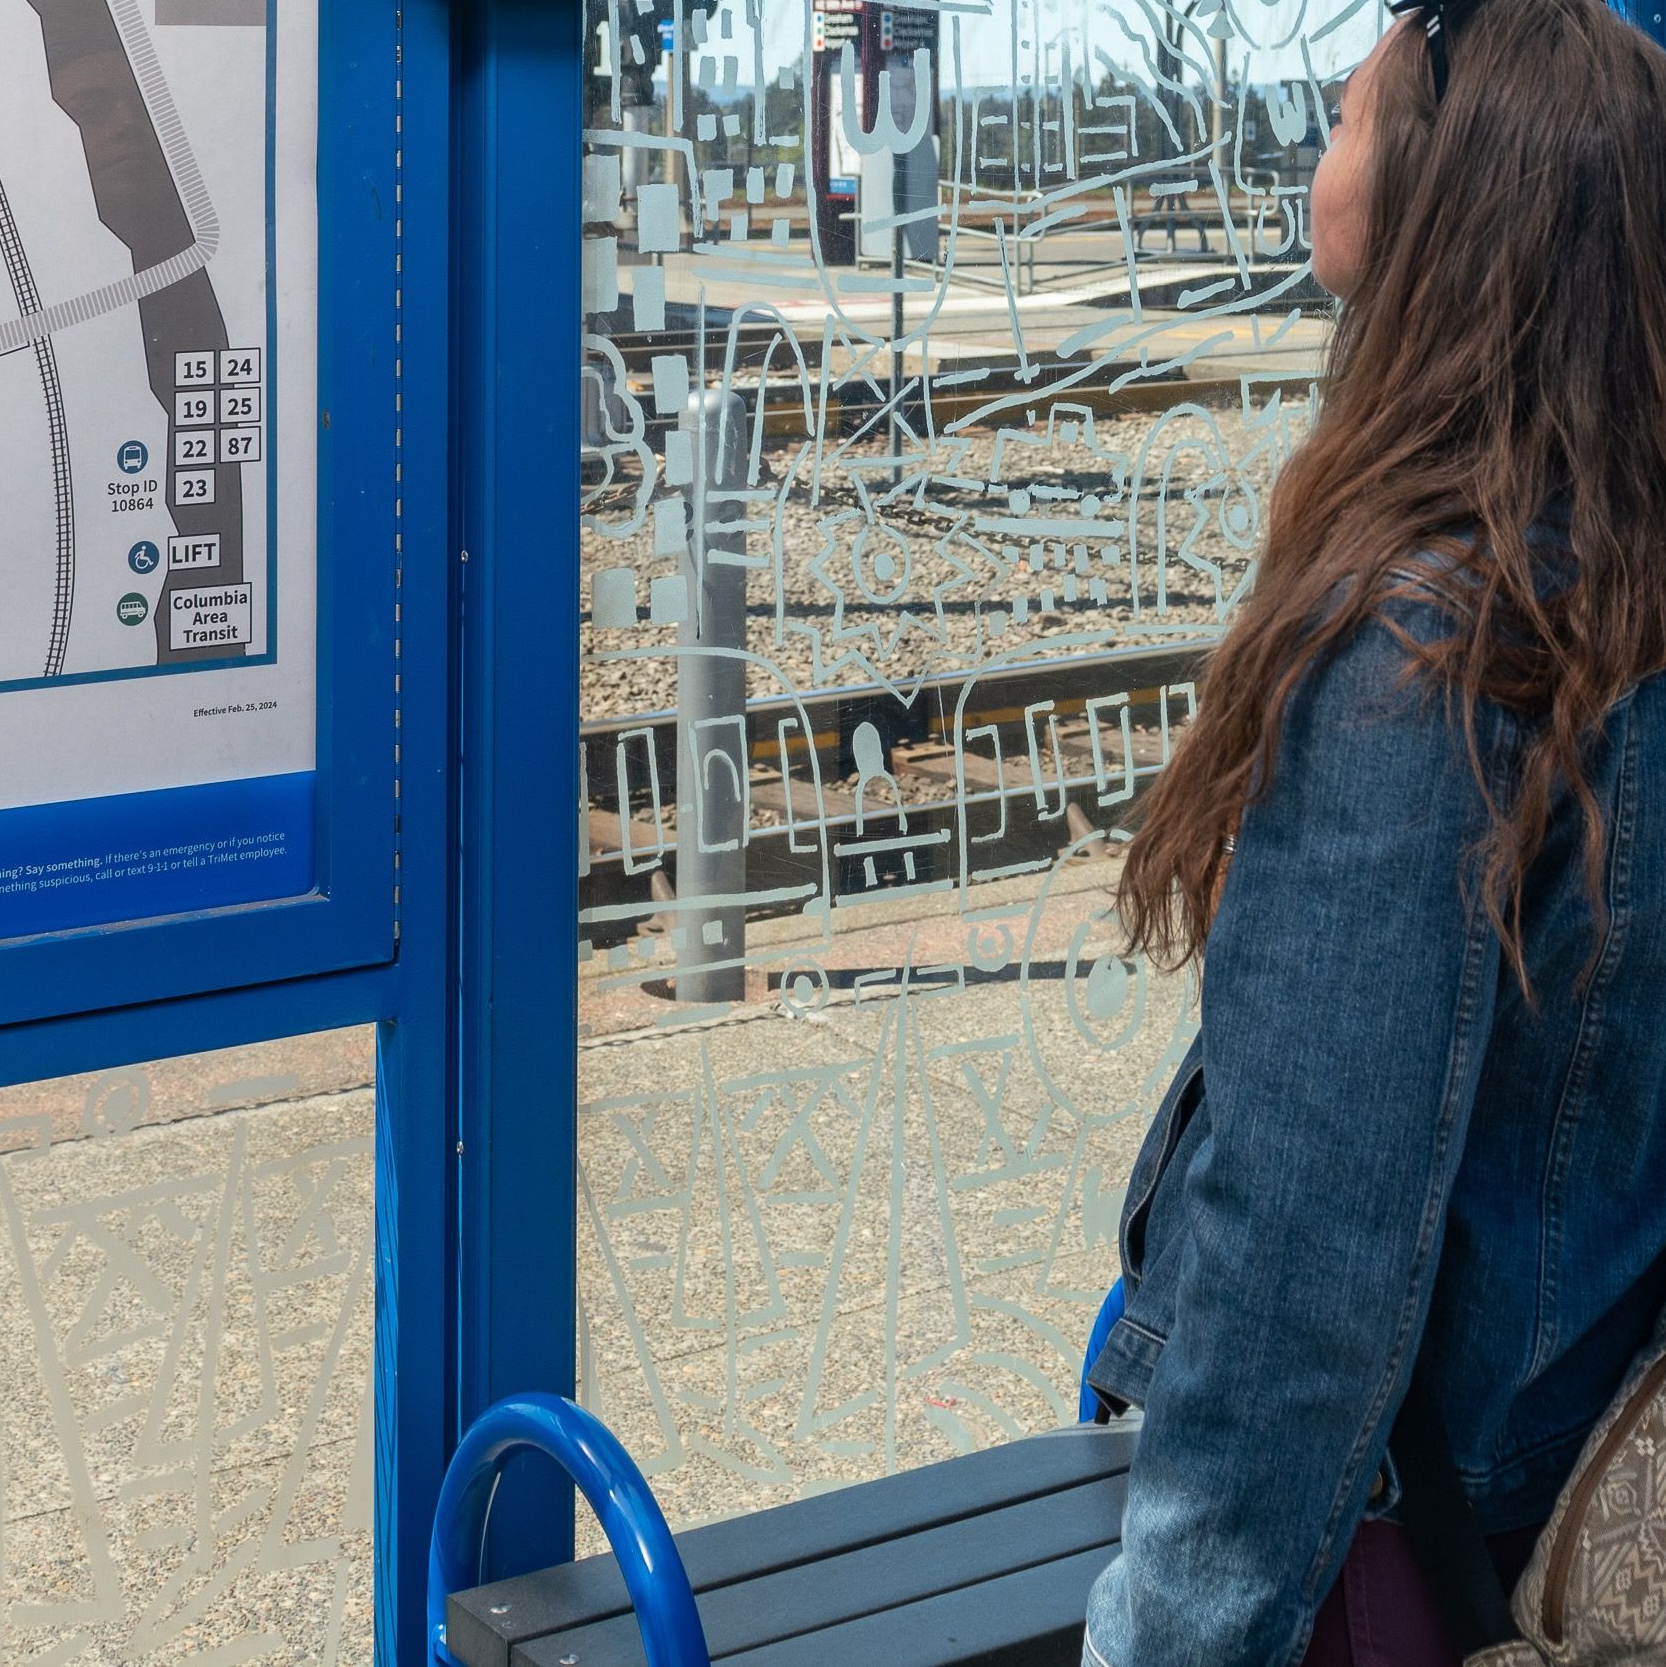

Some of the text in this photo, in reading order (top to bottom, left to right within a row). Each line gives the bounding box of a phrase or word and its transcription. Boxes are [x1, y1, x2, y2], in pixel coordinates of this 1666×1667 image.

[184, 361, 207, 379] 15
[228, 359, 252, 376] 24
[184, 400, 207, 418] 19
[228, 398, 252, 416] 25
[183, 440, 207, 458] 22
[228, 437, 252, 455] 87
[108, 480, 158, 497] Stop ID
[183, 479, 207, 498] 23
[112, 498, 154, 512] 10864
[172, 543, 216, 564] LIFT
[174, 590, 247, 610] Columbia
[193, 612, 228, 626] Area
[183, 625, 238, 643] Transit
[194, 707, 227, 717] Effective
[228, 704, 244, 713] Feb.
[259, 701, 277, 710] 2024
[106, 833, 285, 864] If there's an emergency or if you notice
[26, 866, 44, 876] Say
[47, 858, 103, 872] something.
[39, 874, 93, 888] suspicious,
[95, 868, 112, 880] call
[114, 869, 125, 878] or
[127, 865, 146, 876] text
[148, 862, 168, 873] 9-1-1
[171, 862, 181, 870] or
[183, 857, 198, 868] tell
[208, 853, 238, 864] TriMet
[240, 847, 287, 860] employee.
